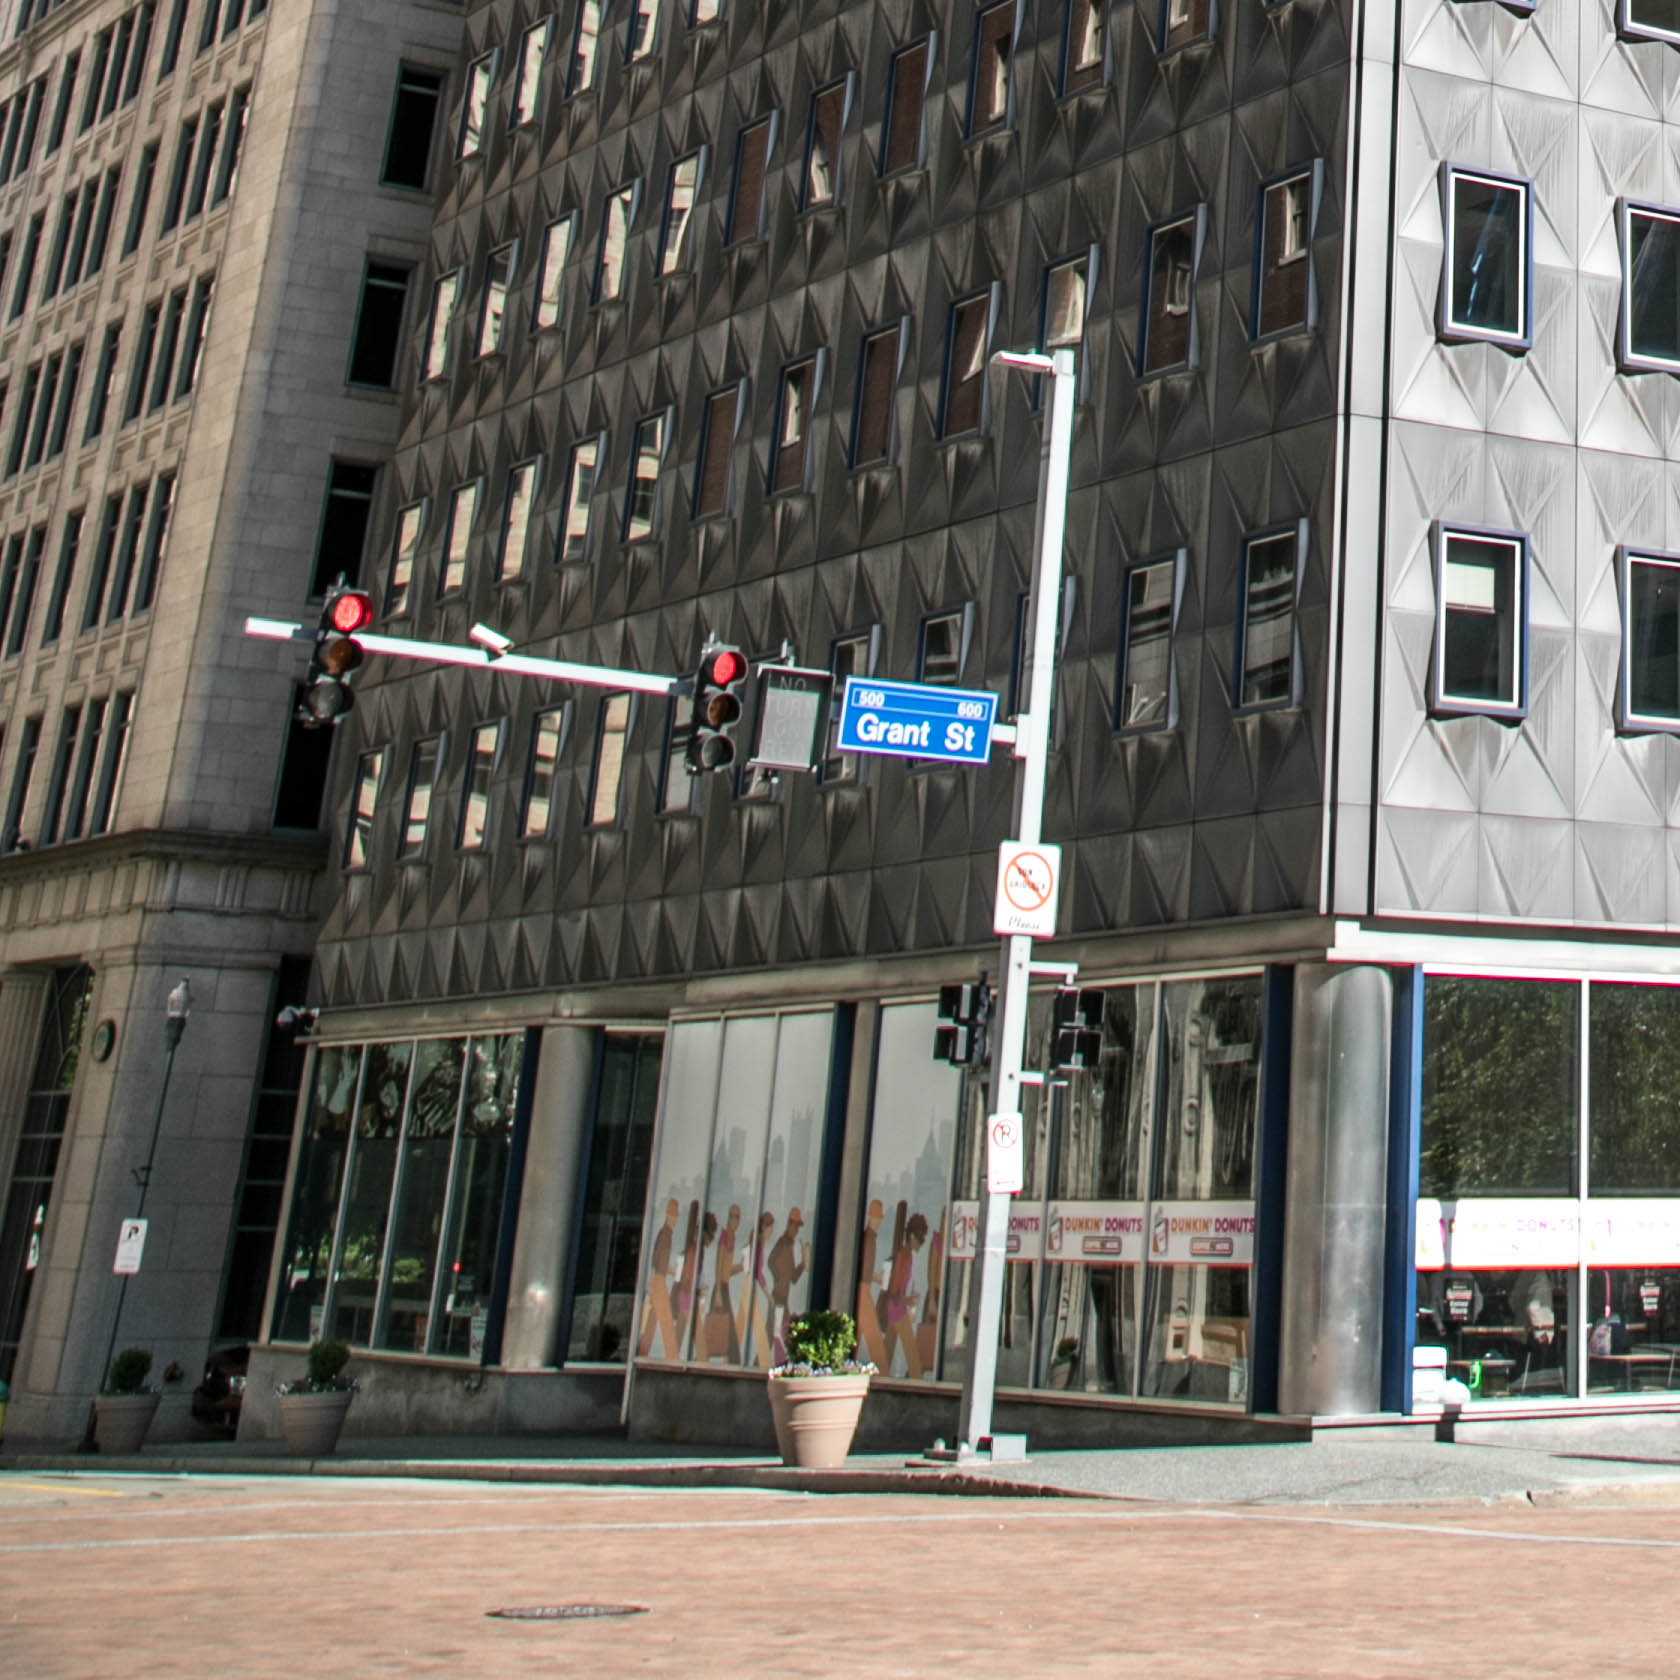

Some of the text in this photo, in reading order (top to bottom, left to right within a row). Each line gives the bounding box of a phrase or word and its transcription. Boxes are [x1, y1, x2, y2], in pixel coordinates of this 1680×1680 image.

[780, 676, 807, 690] NO
[859, 691, 983, 718] 500 600
[857, 713, 975, 752] Grant St
[1009, 1217, 1041, 1232] ONUTS
[1065, 1217, 1143, 1232] DUNKIN' DONUTS
[1171, 1217, 1255, 1233] DUNKIN' DONUTS
